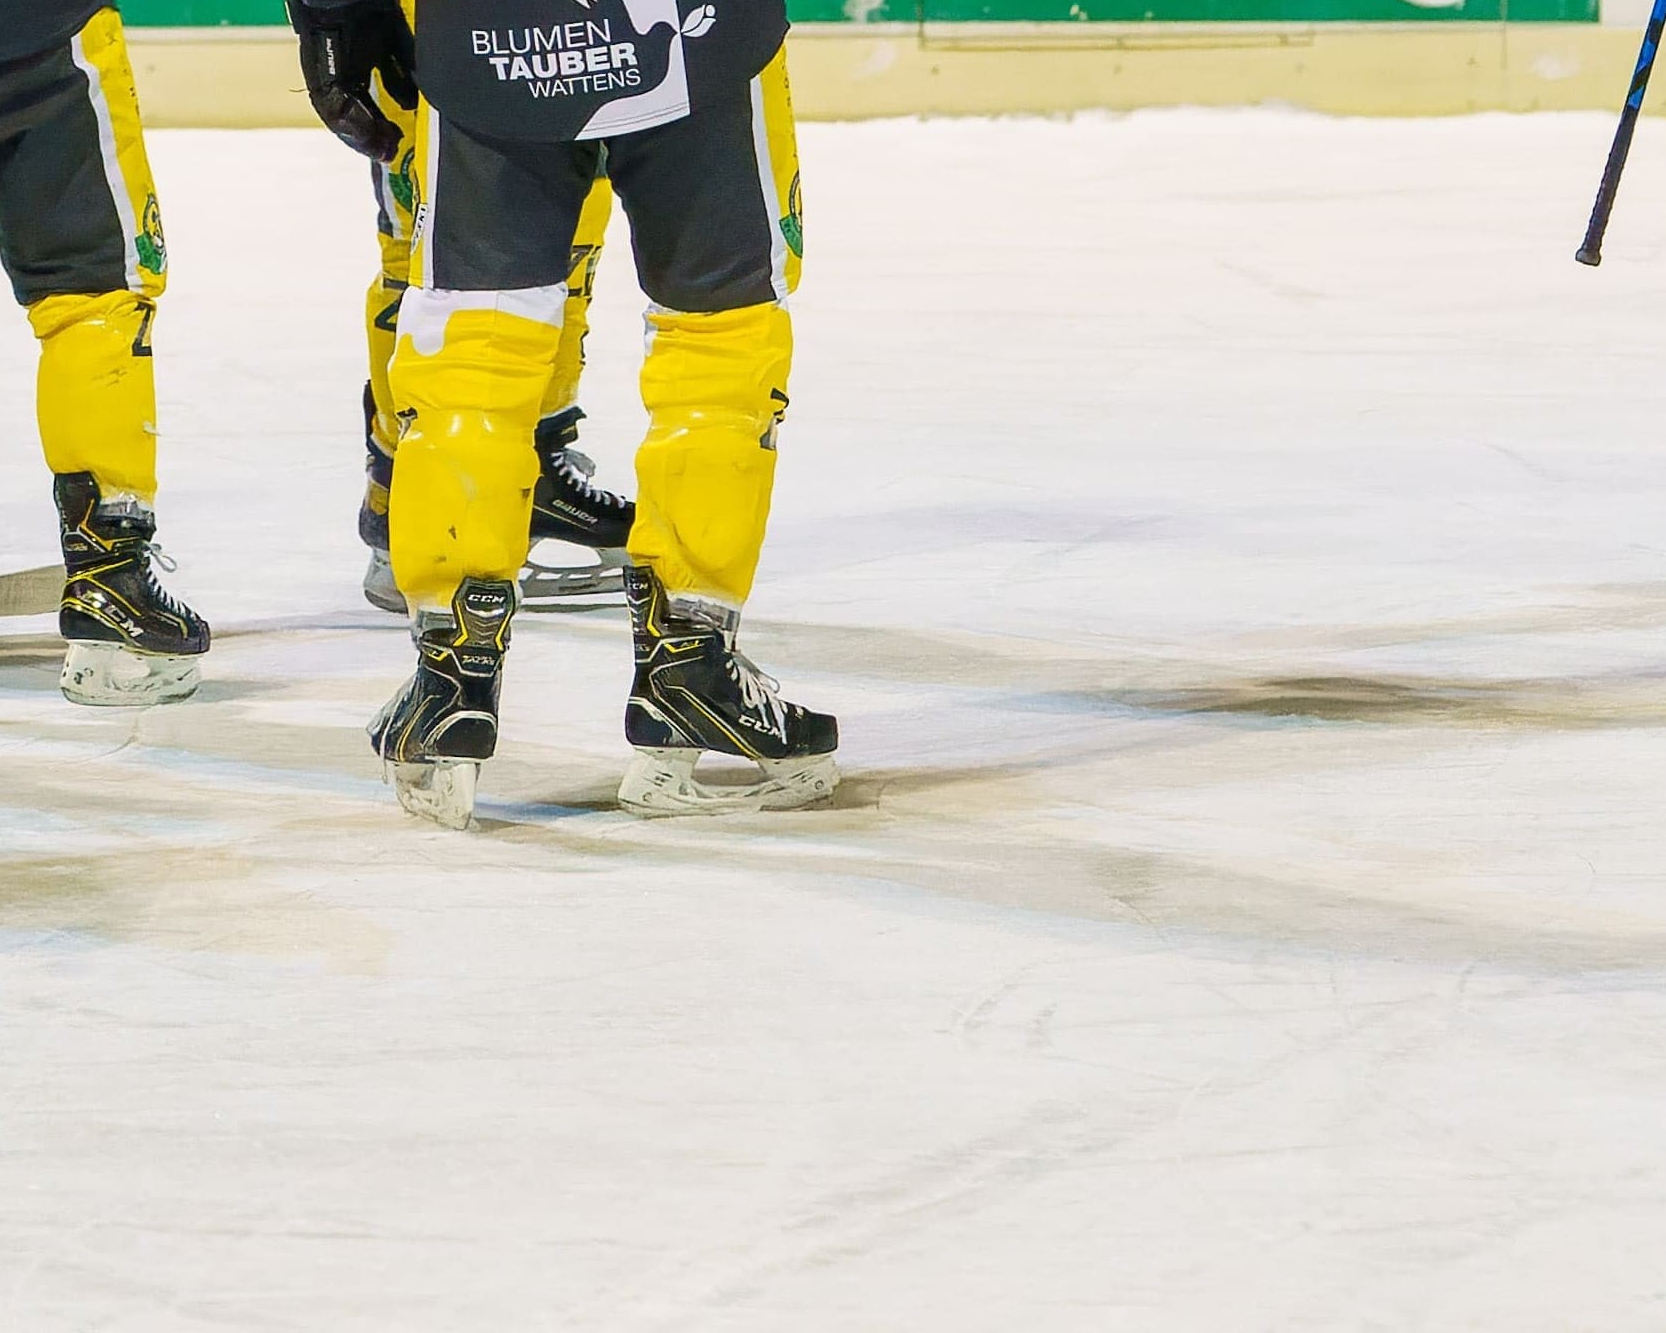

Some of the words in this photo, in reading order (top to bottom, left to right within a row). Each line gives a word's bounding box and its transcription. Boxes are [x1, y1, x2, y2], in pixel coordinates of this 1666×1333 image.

[471, 17, 612, 57] BLUMEN
[488, 41, 639, 82] TAUBER
[527, 67, 642, 100] WATTENS
[467, 592, 507, 605] CCM
